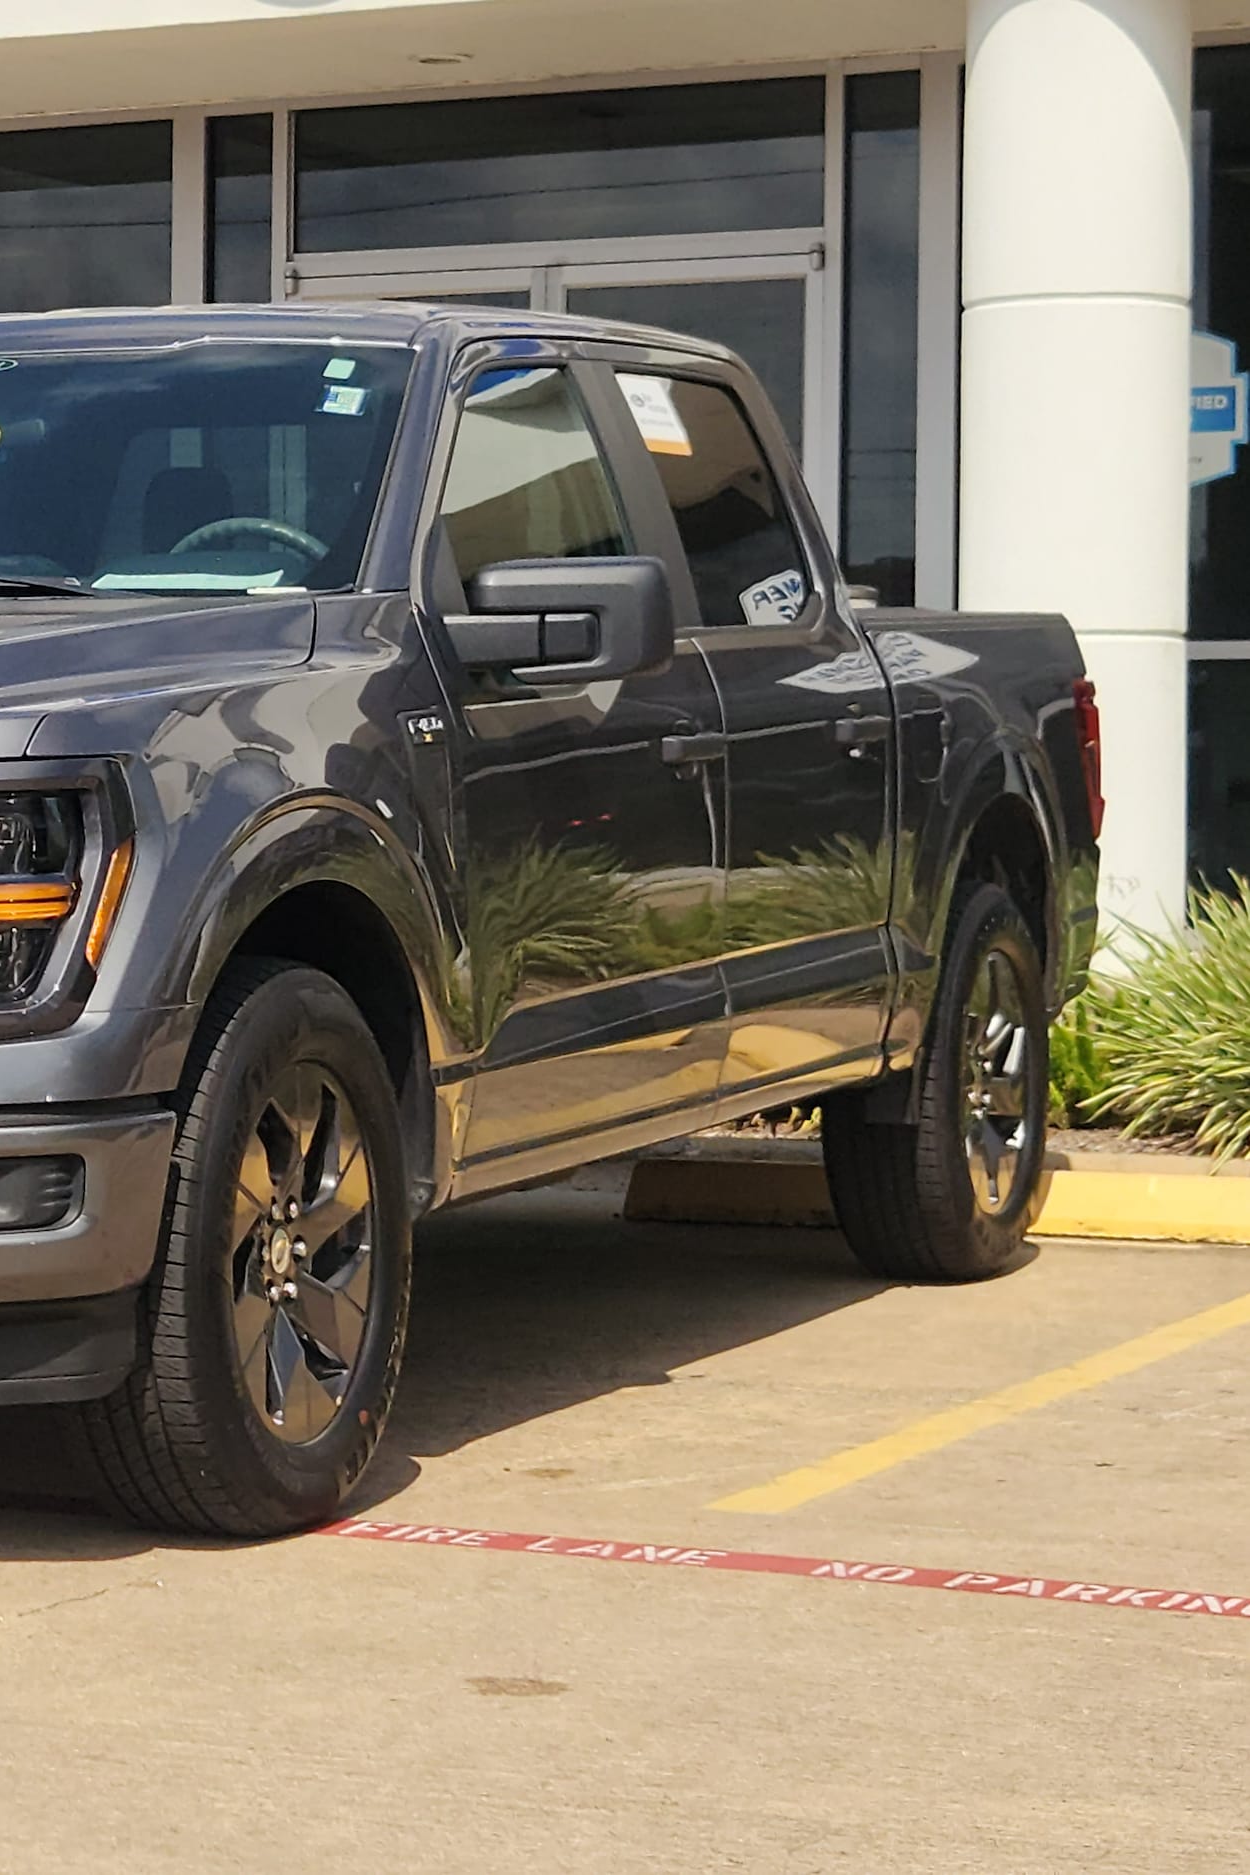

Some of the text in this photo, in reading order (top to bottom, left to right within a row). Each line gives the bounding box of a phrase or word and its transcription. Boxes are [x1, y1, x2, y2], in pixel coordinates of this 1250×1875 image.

[338, 1519, 1250, 1617] FIRE LANE NO PARKIN
